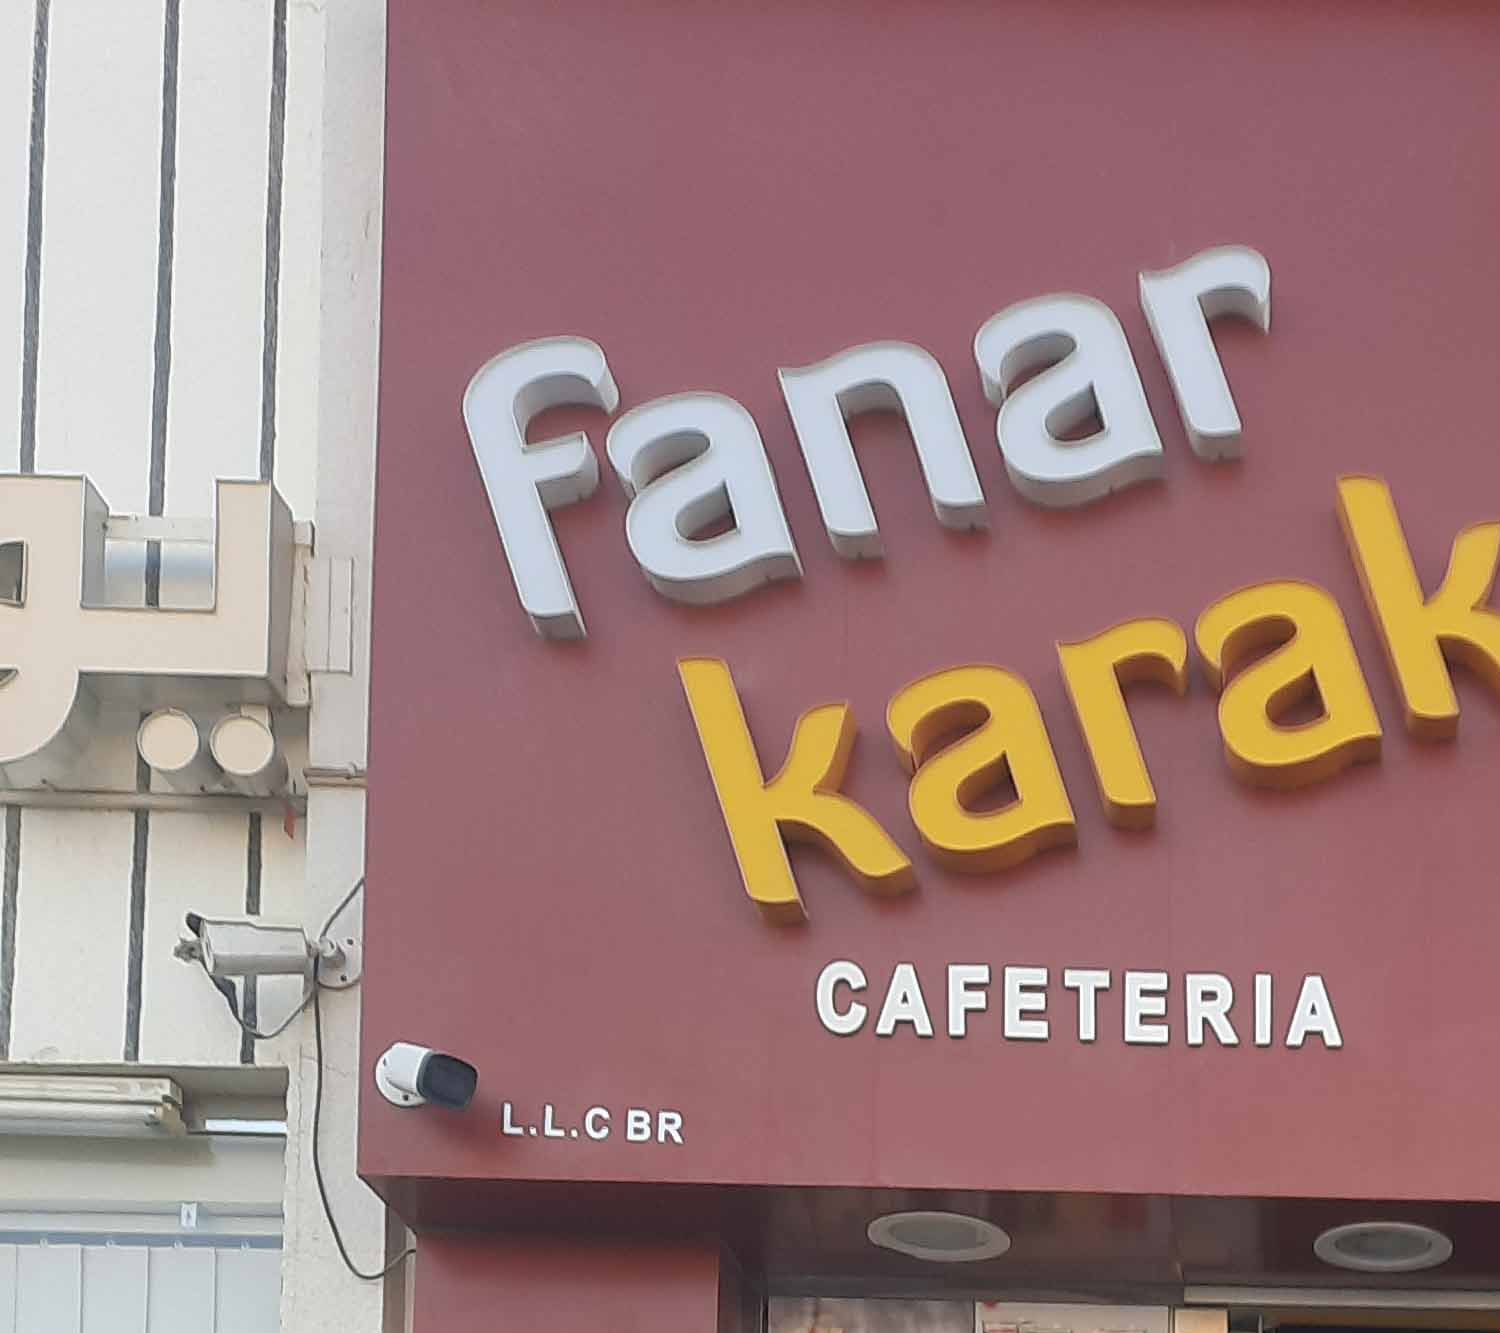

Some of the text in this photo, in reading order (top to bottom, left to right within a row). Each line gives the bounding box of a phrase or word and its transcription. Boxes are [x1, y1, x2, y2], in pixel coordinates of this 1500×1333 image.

[461, 244, 1271, 639] fanar
[814, 961, 1343, 1048] CAFETERIA
[502, 1102, 685, 1145] L.L.C BR
